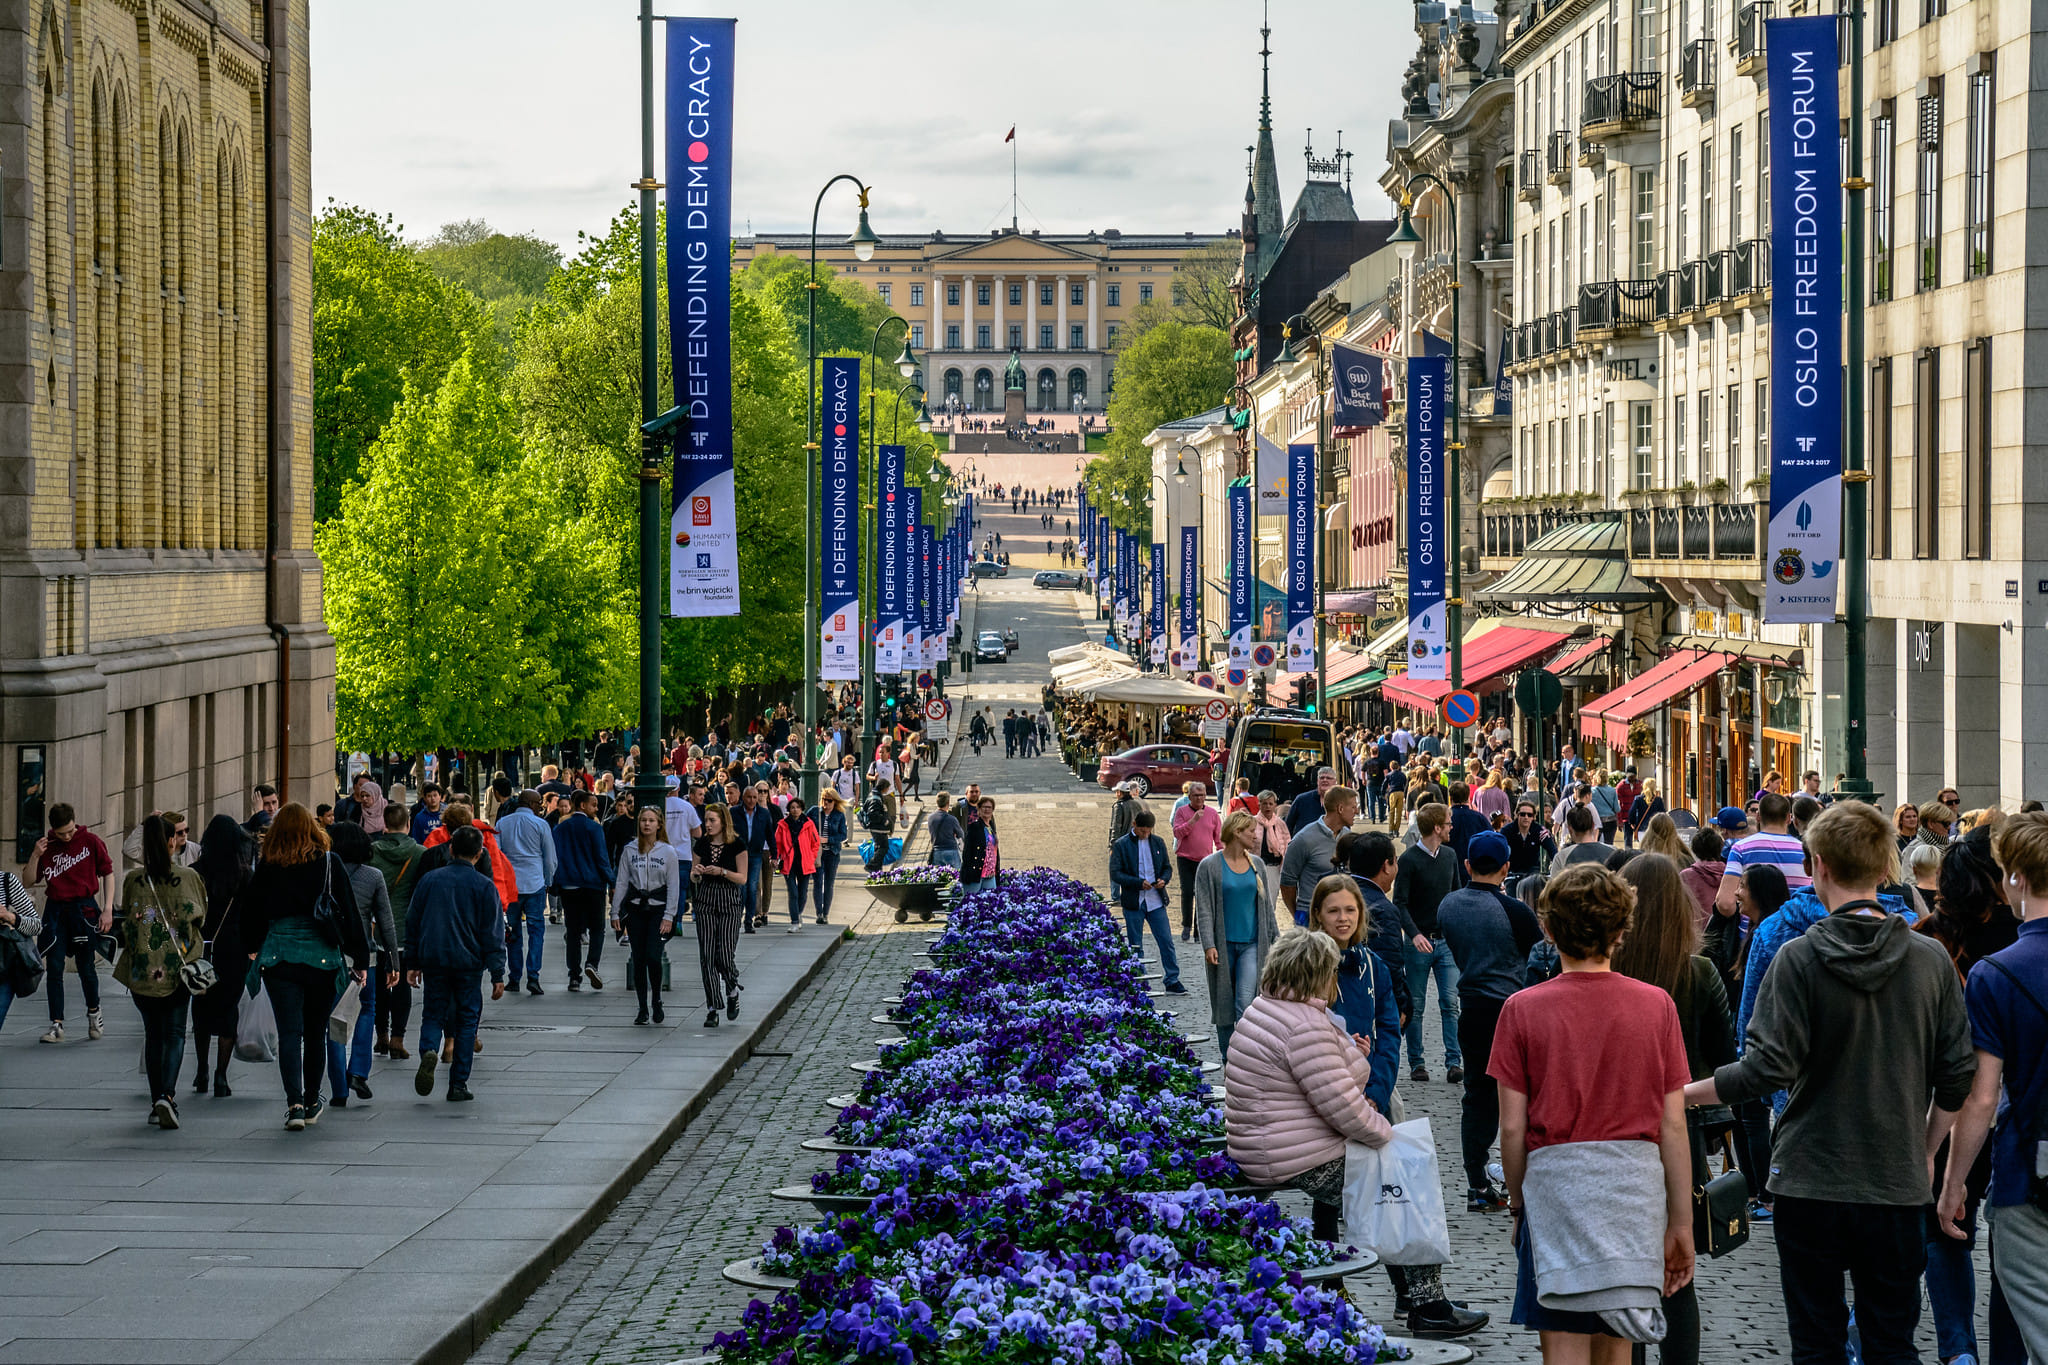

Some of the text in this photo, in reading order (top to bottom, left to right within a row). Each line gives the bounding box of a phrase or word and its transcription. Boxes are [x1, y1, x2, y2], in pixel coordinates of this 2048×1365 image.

[1791, 51, 1818, 407] OSLO FREEDOM FORUM
[687, 242, 709, 419] DEFENDING
[1419, 375, 1433, 565] OSLO FREEDOM FORUM
[833, 479, 846, 575] DEFENDING
[885, 531, 895, 600] DEFENDING
[1236, 496, 1245, 605] OSLO FREEDOM FORUM
[1296, 456, 1306, 592] OSLO FREEDOM FORUM
[905, 555, 914, 611] DEFENDING
[1185, 533, 1193, 620] OSLO FREEDOM FORUM
[1915, 631, 1930, 662] DNB
[44, 846, 90, 881] Hundreds
